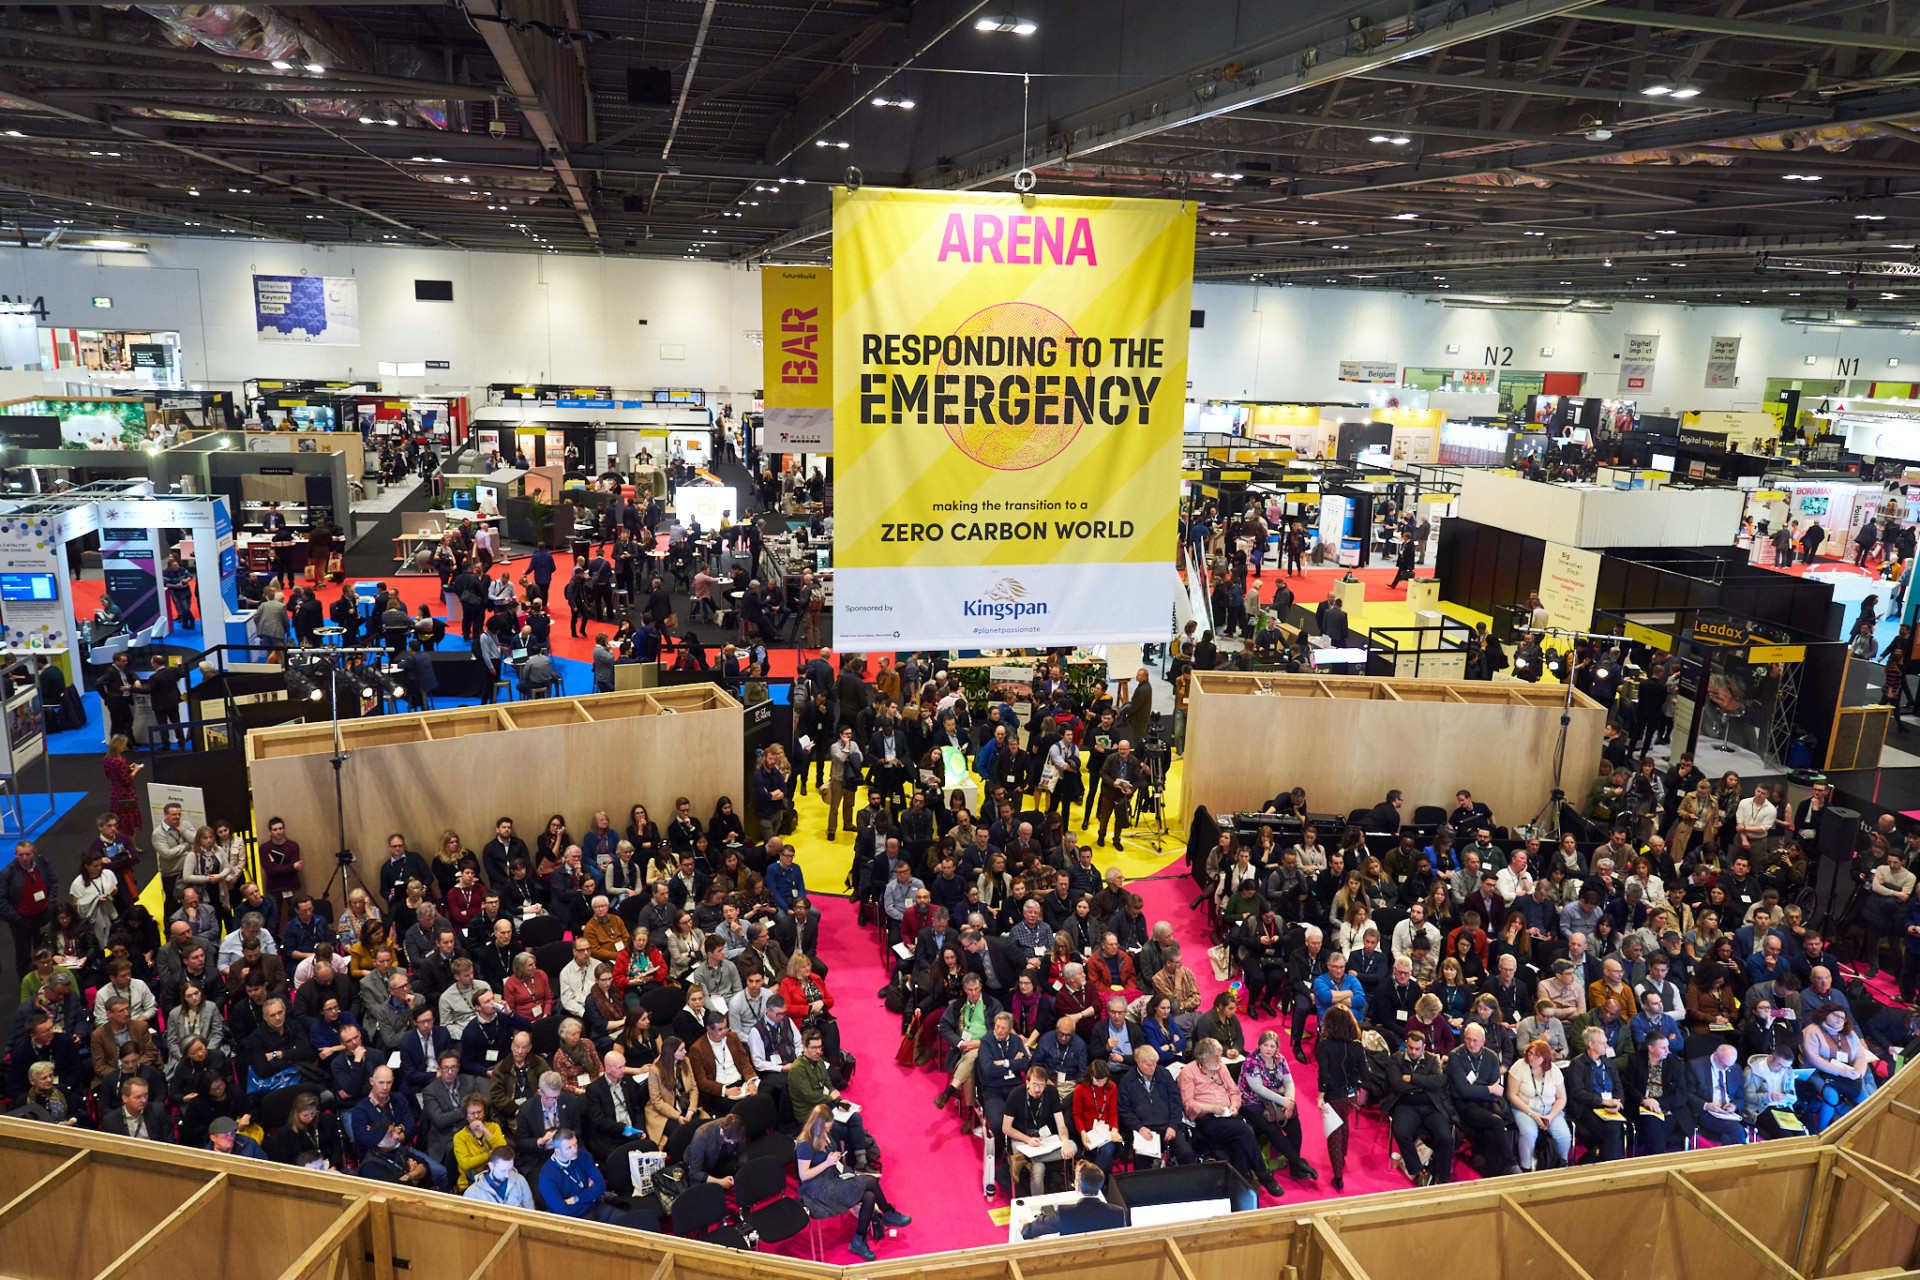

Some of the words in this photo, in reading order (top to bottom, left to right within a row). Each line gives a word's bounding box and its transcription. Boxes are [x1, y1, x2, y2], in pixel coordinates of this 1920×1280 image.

[937, 213, 1098, 266] ARENA
[781, 307, 818, 384] BAR
[862, 334, 1058, 367] RESPONDING
[1065, 337, 1101, 368] TO
[1109, 338, 1164, 368] THE
[1630, 340, 1651, 348] Digital
[1484, 346, 1514, 367] N2
[1368, 370, 1396, 379] Belgium
[1837, 358, 1860, 376] N1
[860, 373, 1162, 426] EMERGENCY
[1680, 435, 1701, 444] Digital
[933, 500, 978, 513] making
[982, 500, 1001, 511] the
[1005, 499, 1061, 511] transition
[1065, 500, 1077, 510] to
[1080, 502, 1088, 510] a
[881, 523, 944, 542] ZERO
[951, 522, 1047, 541] CARBON
[1054, 520, 1134, 539] WORLD
[845, 605, 883, 613] Sponsored
[884, 604, 894, 612] by
[963, 598, 1048, 620] Kingspan
[973, 626, 1041, 635] #planetpassionate
[1694, 620, 1743, 640] Leadax
